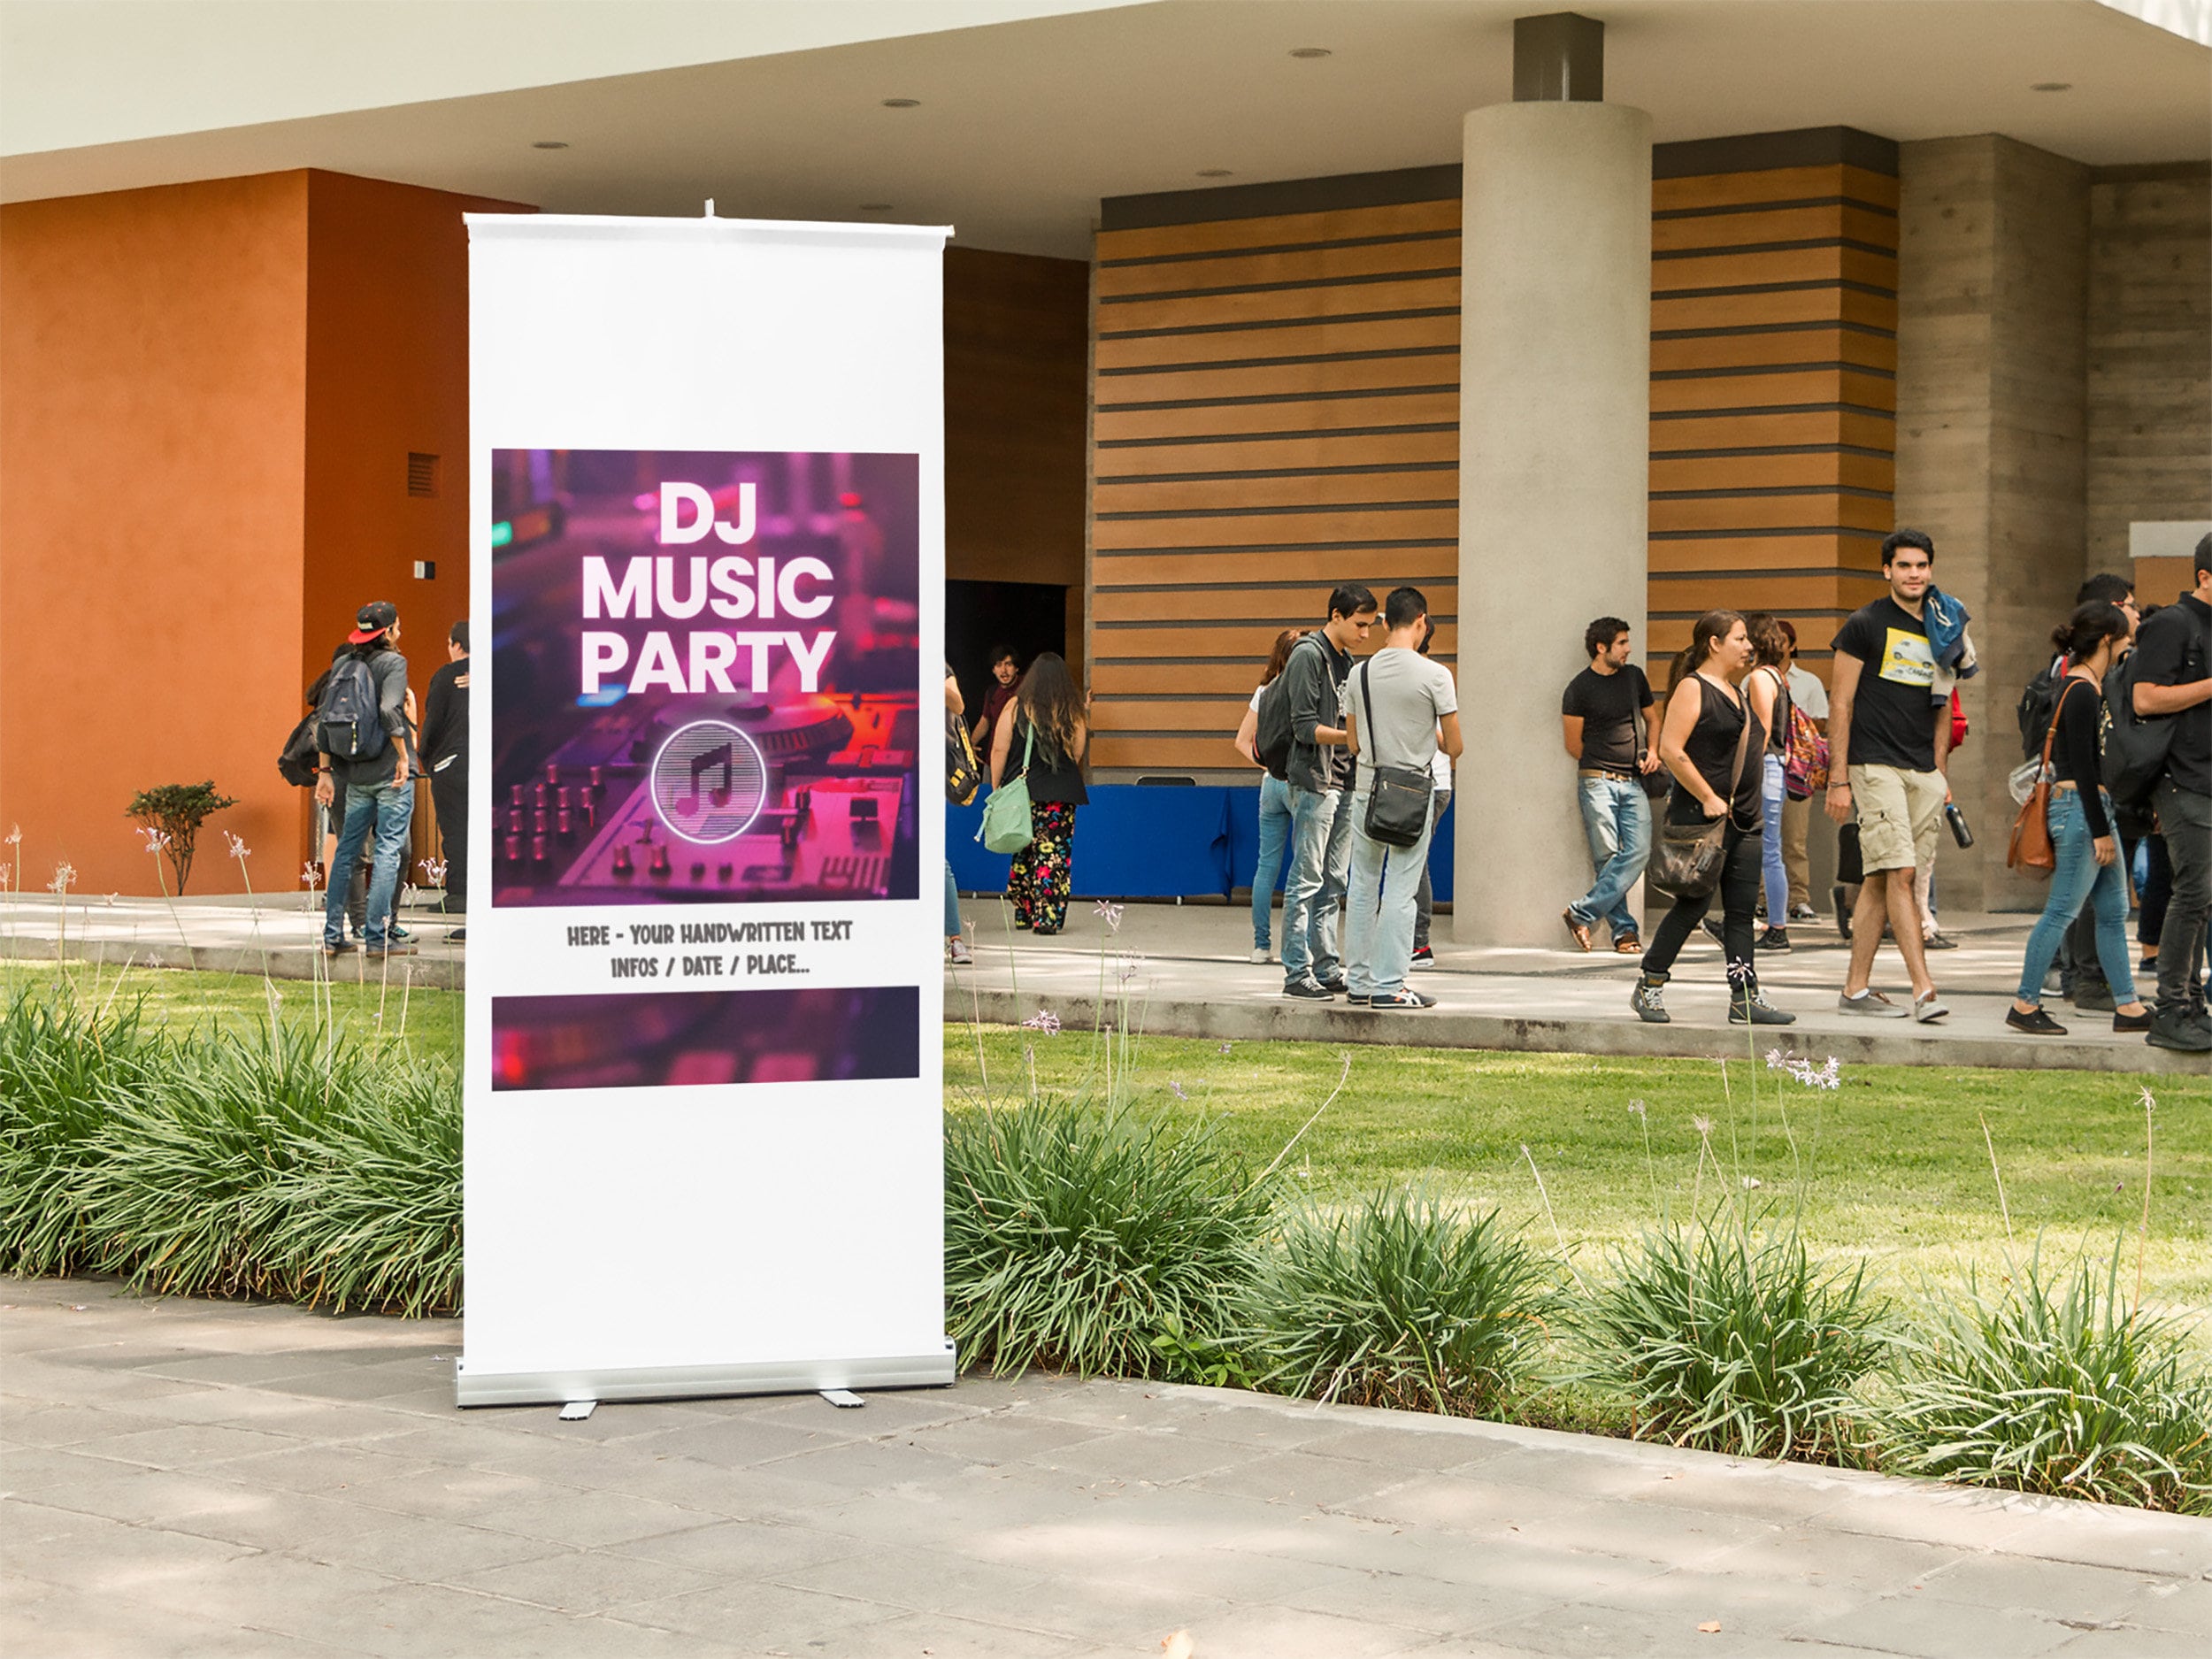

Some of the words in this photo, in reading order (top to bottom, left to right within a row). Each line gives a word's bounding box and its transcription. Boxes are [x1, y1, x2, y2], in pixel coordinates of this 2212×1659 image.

[659, 481, 757, 545] DJ
[581, 556, 834, 619] MUSIC
[581, 630, 837, 695] PARTY
[566, 925, 611, 947] HERE
[629, 923, 675, 946] YOUR
[680, 920, 805, 944] HANDWRITTEN
[810, 919, 854, 941] TEXT
[611, 956, 659, 979] INFOS
[682, 955, 724, 977] DATE
[746, 953, 810, 976] PLACE...
